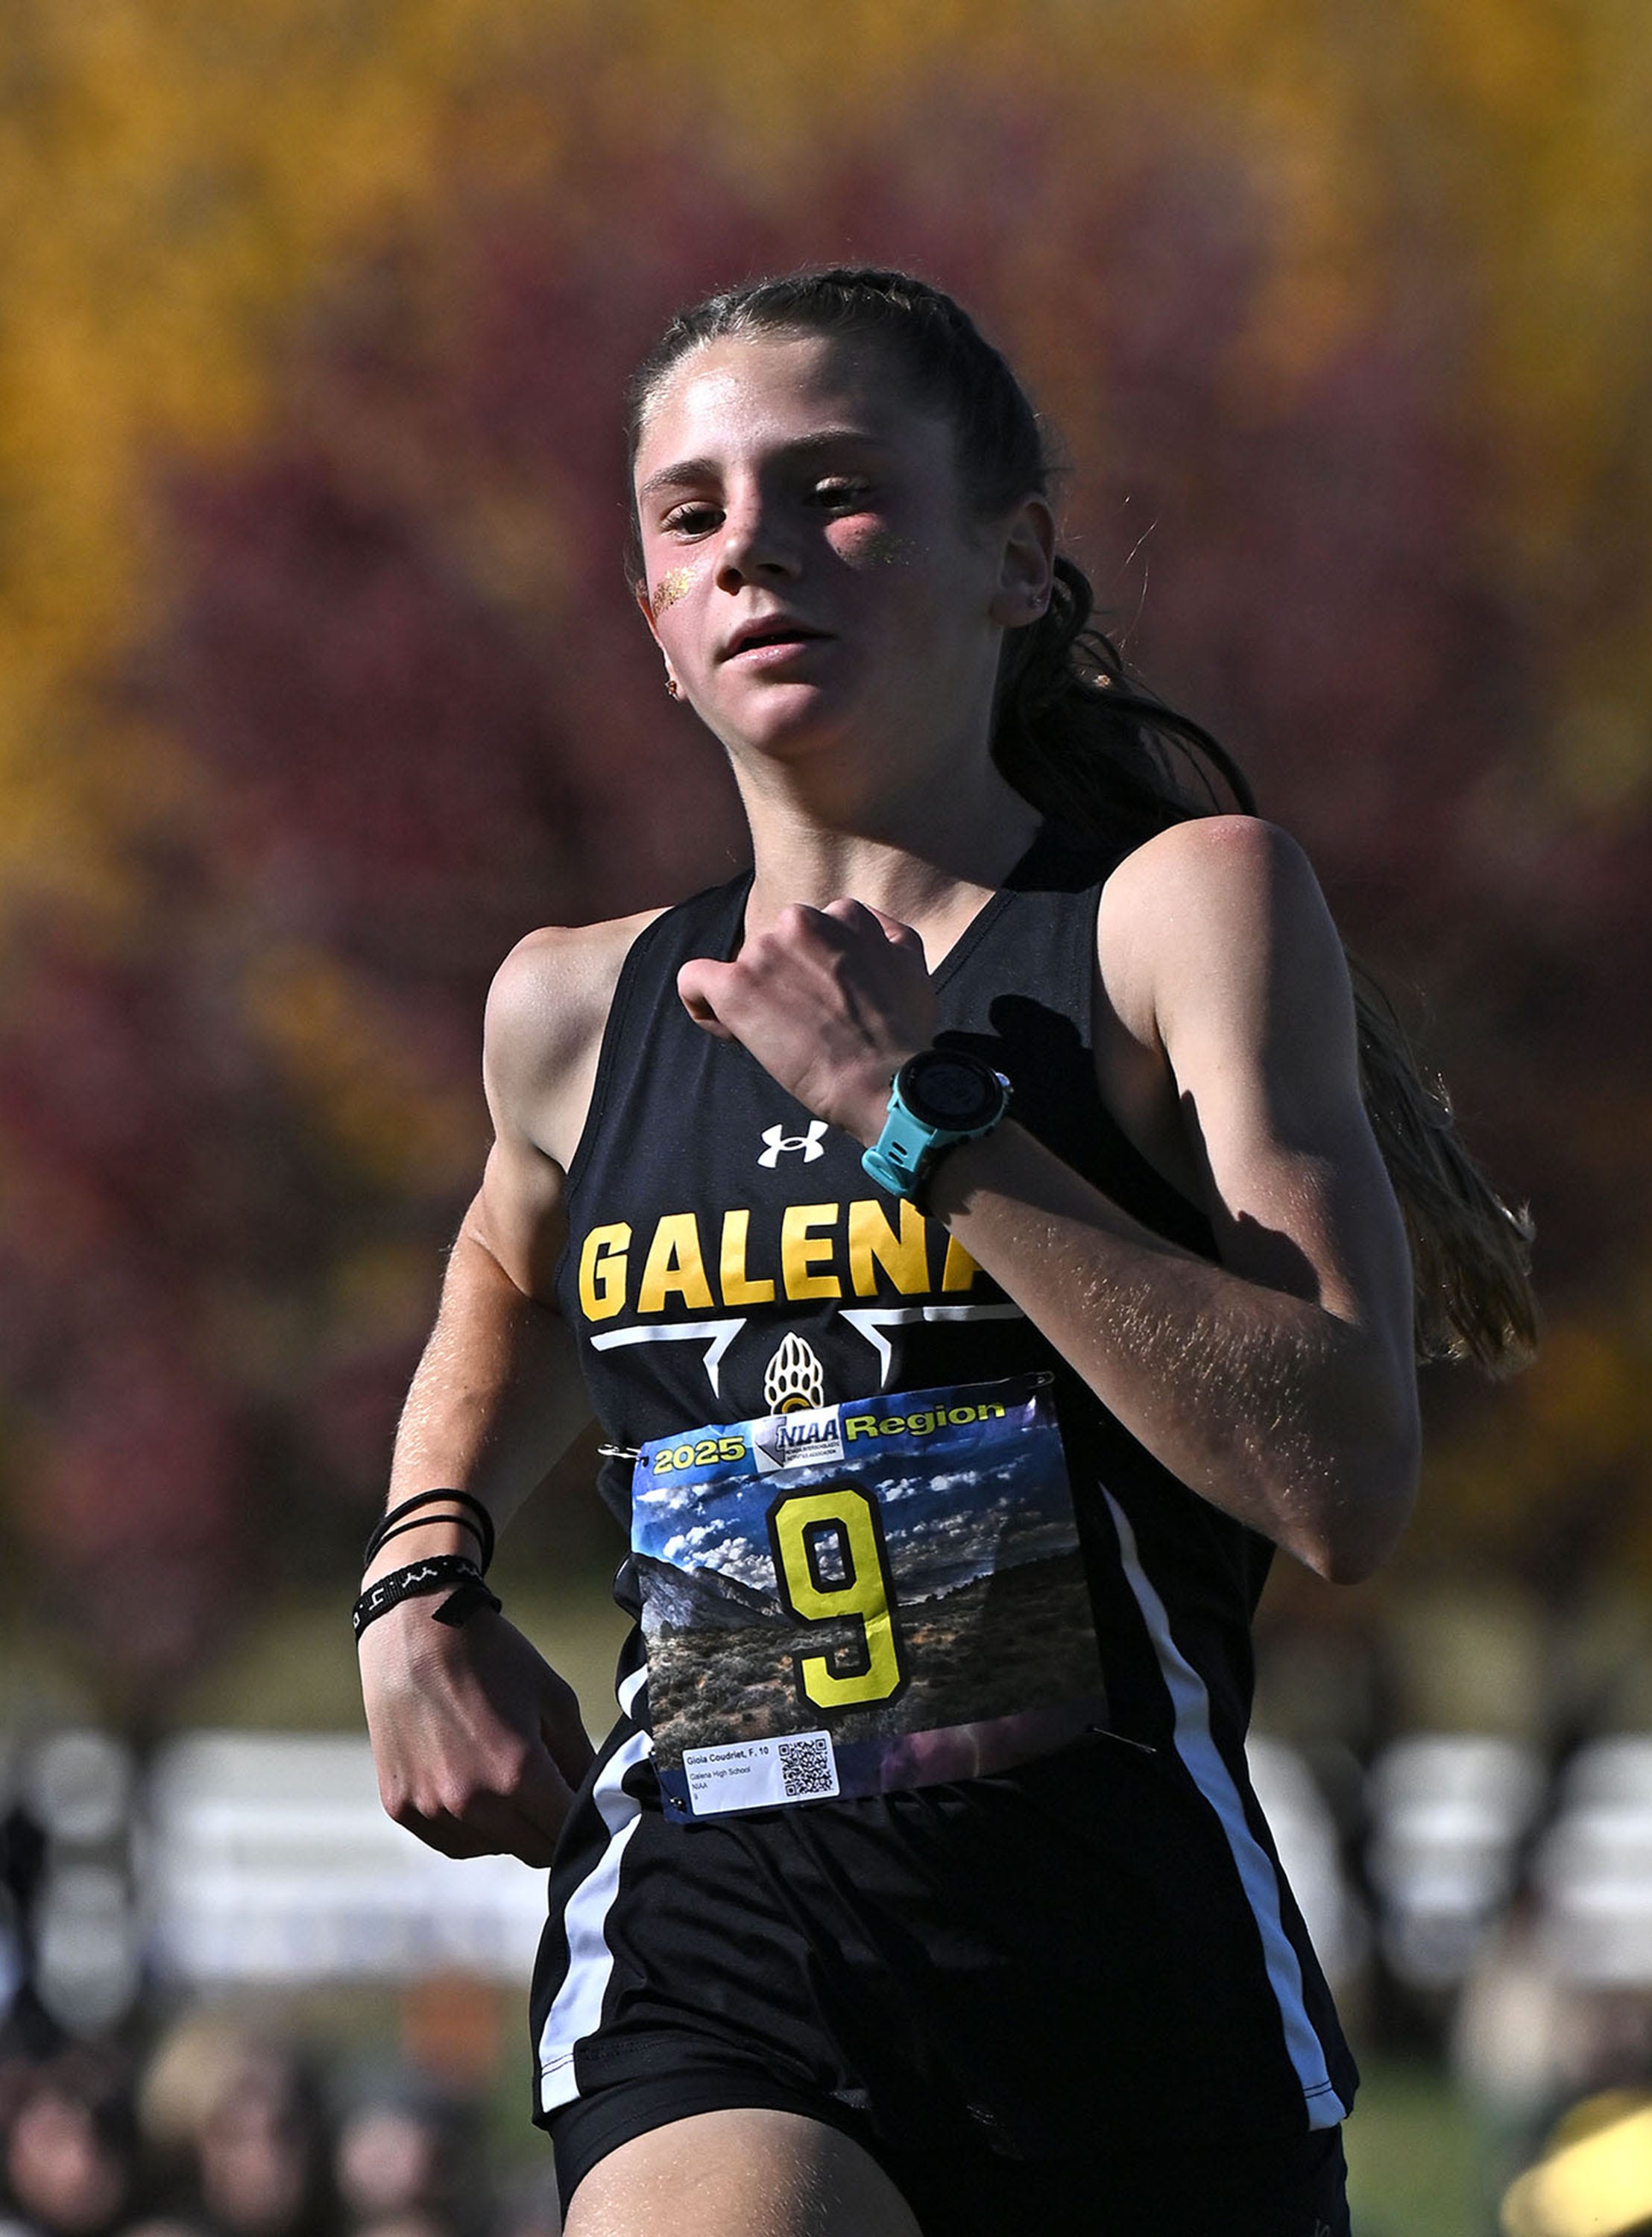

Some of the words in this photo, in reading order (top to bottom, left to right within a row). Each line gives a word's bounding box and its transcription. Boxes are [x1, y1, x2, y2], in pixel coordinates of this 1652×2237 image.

[778, 1418, 839, 1448] NIAA
[845, 1401, 1006, 1442] Region
[652, 1436, 746, 1476] 2025
[775, 1490, 901, 1708] 9
[687, 1756, 707, 1765] Gioia
[759, 1746, 769, 1755] 10
[690, 1772, 712, 1781] Galena
[713, 1770, 728, 1778] High
[728, 1766, 751, 1775] School
